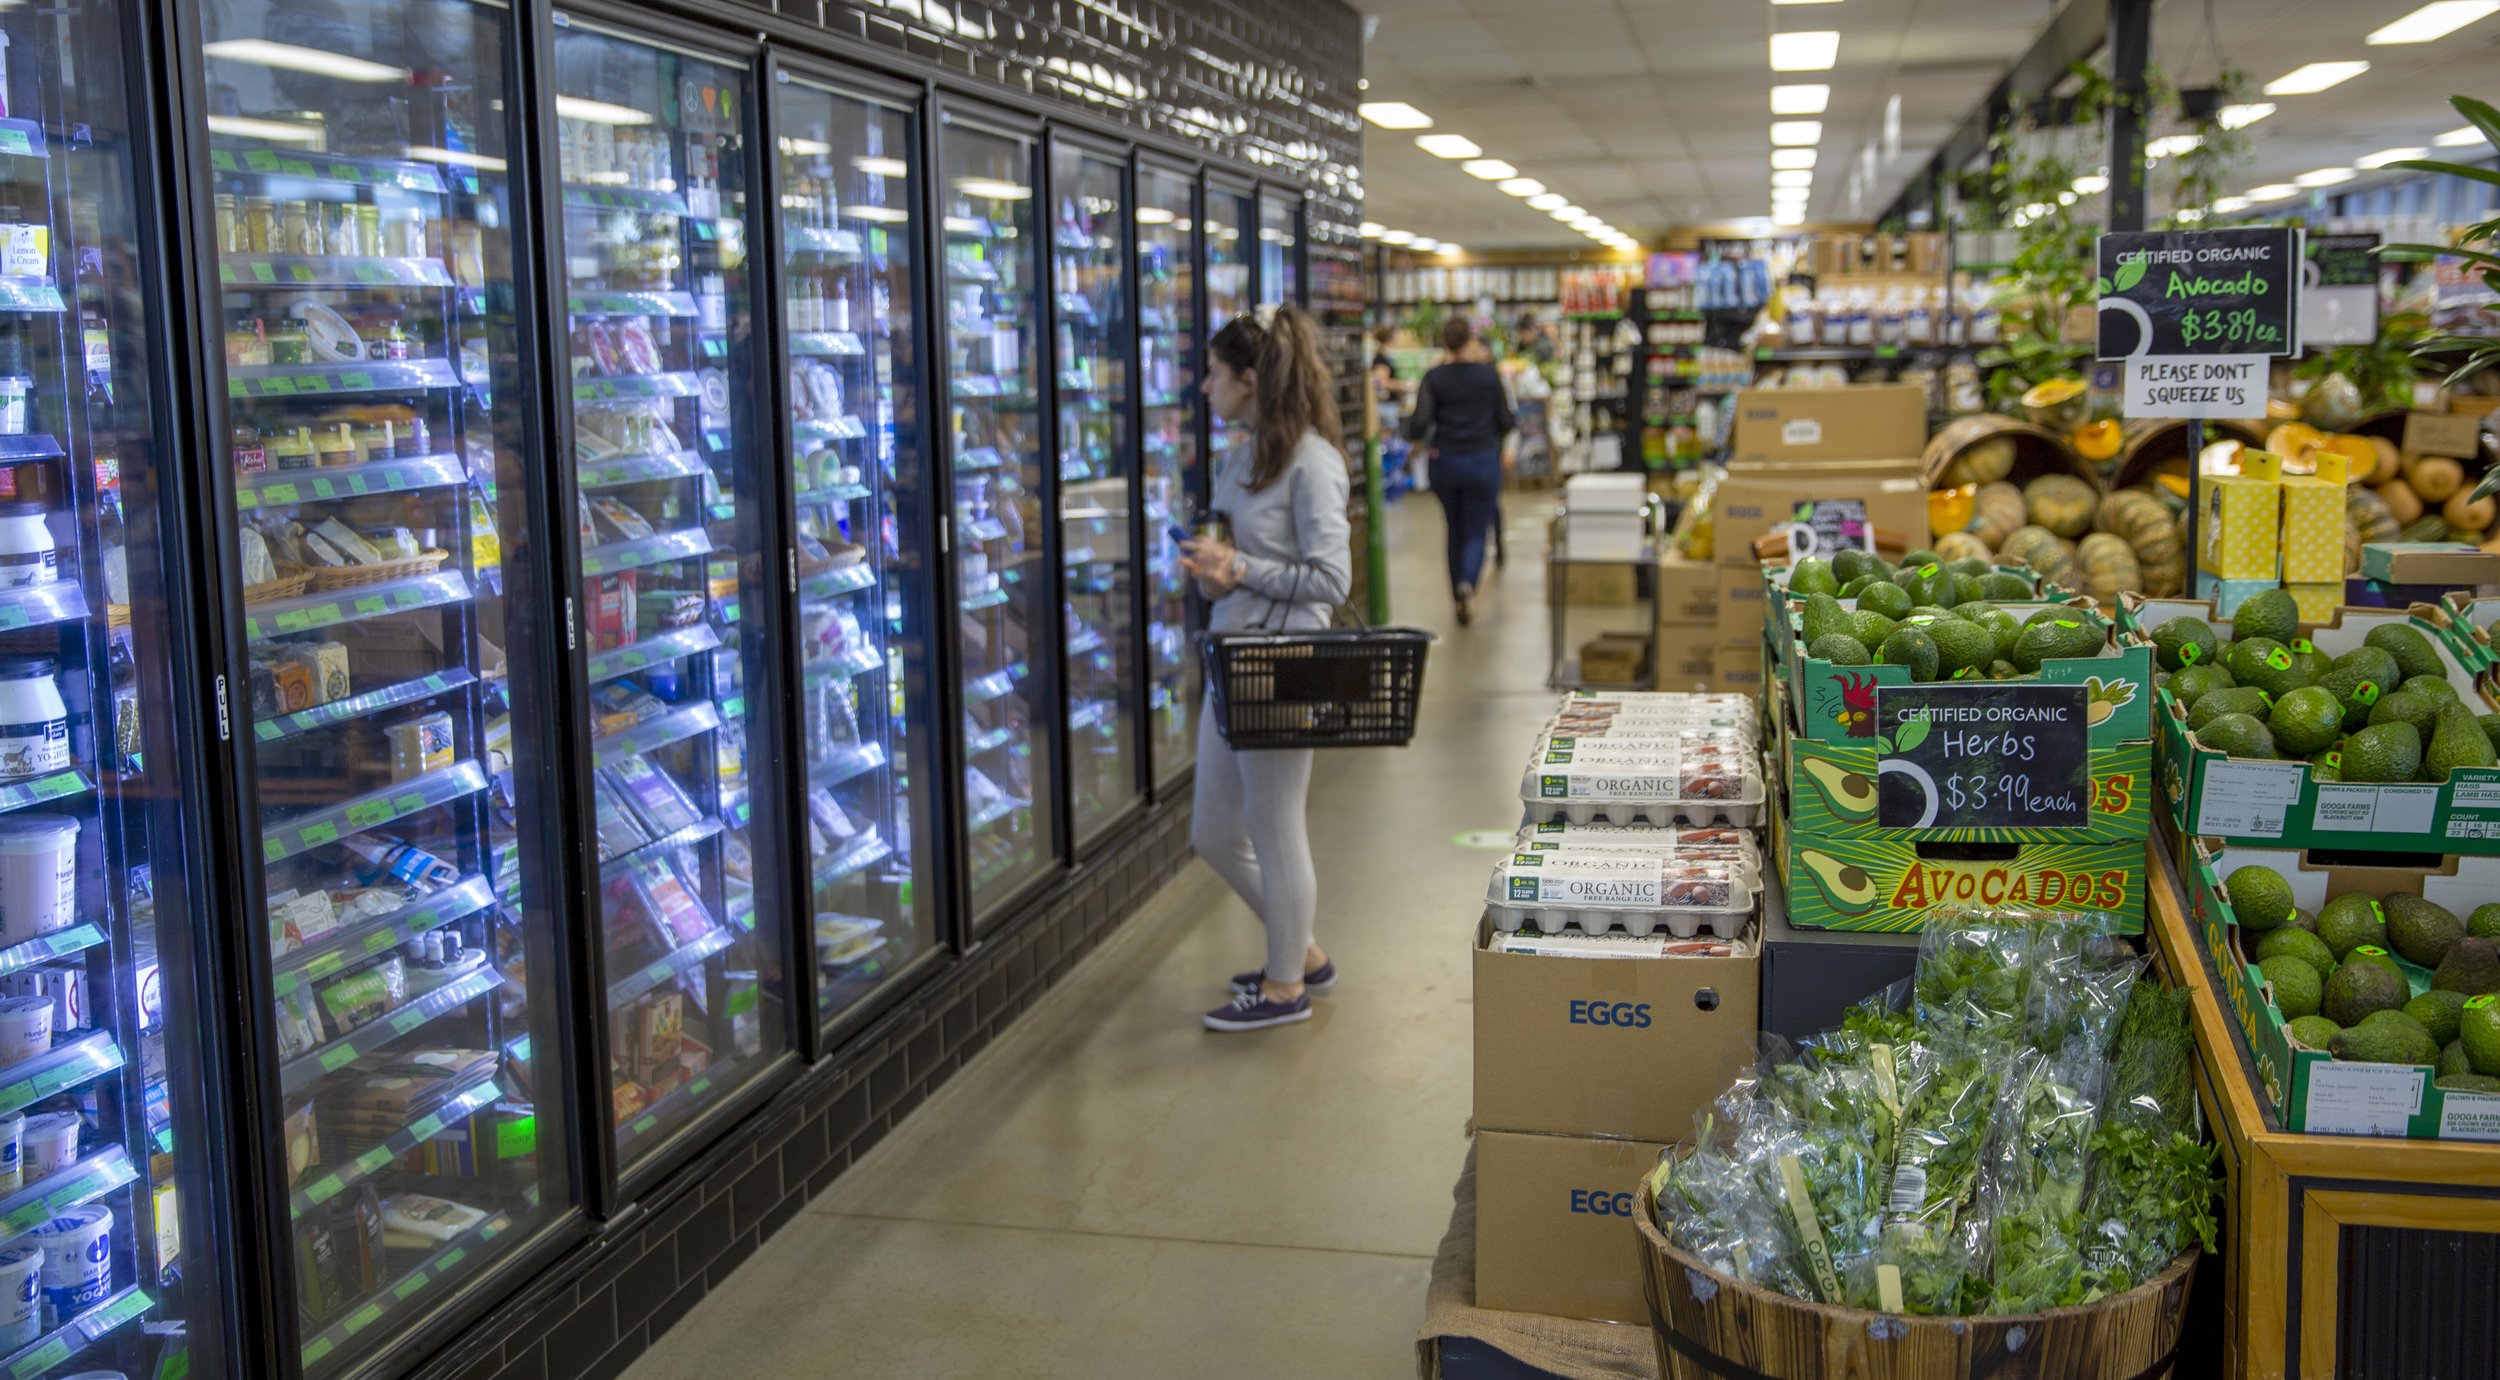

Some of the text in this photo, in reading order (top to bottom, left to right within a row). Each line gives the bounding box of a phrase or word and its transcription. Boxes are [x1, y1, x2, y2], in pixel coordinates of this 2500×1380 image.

[12, 245, 36, 255] Lemon
[17, 256, 39, 264] Cream
[2116, 246, 2271, 266] CERTIFIED ORGANIC
[2165, 270, 2269, 300] Avocado
[2140, 362, 2255, 383] PLEASE DON'T
[2143, 386, 2246, 405] SQUEEZE US
[218, 679, 229, 737] PULL
[1897, 707, 2068, 723] CERTIFIED ORGANIC
[1943, 729, 2036, 761] Herbs
[1596, 778, 1674, 792] ORGANIC
[1513, 889, 1521, 898] 12
[1570, 881, 1655, 897] ORGANIC
[1888, 860, 2129, 911] AVOCADOS
[2208, 922, 2257, 1054] GOOGA
[1569, 1000, 1652, 1029] EGGS
[1570, 1189, 1634, 1218] EGG
